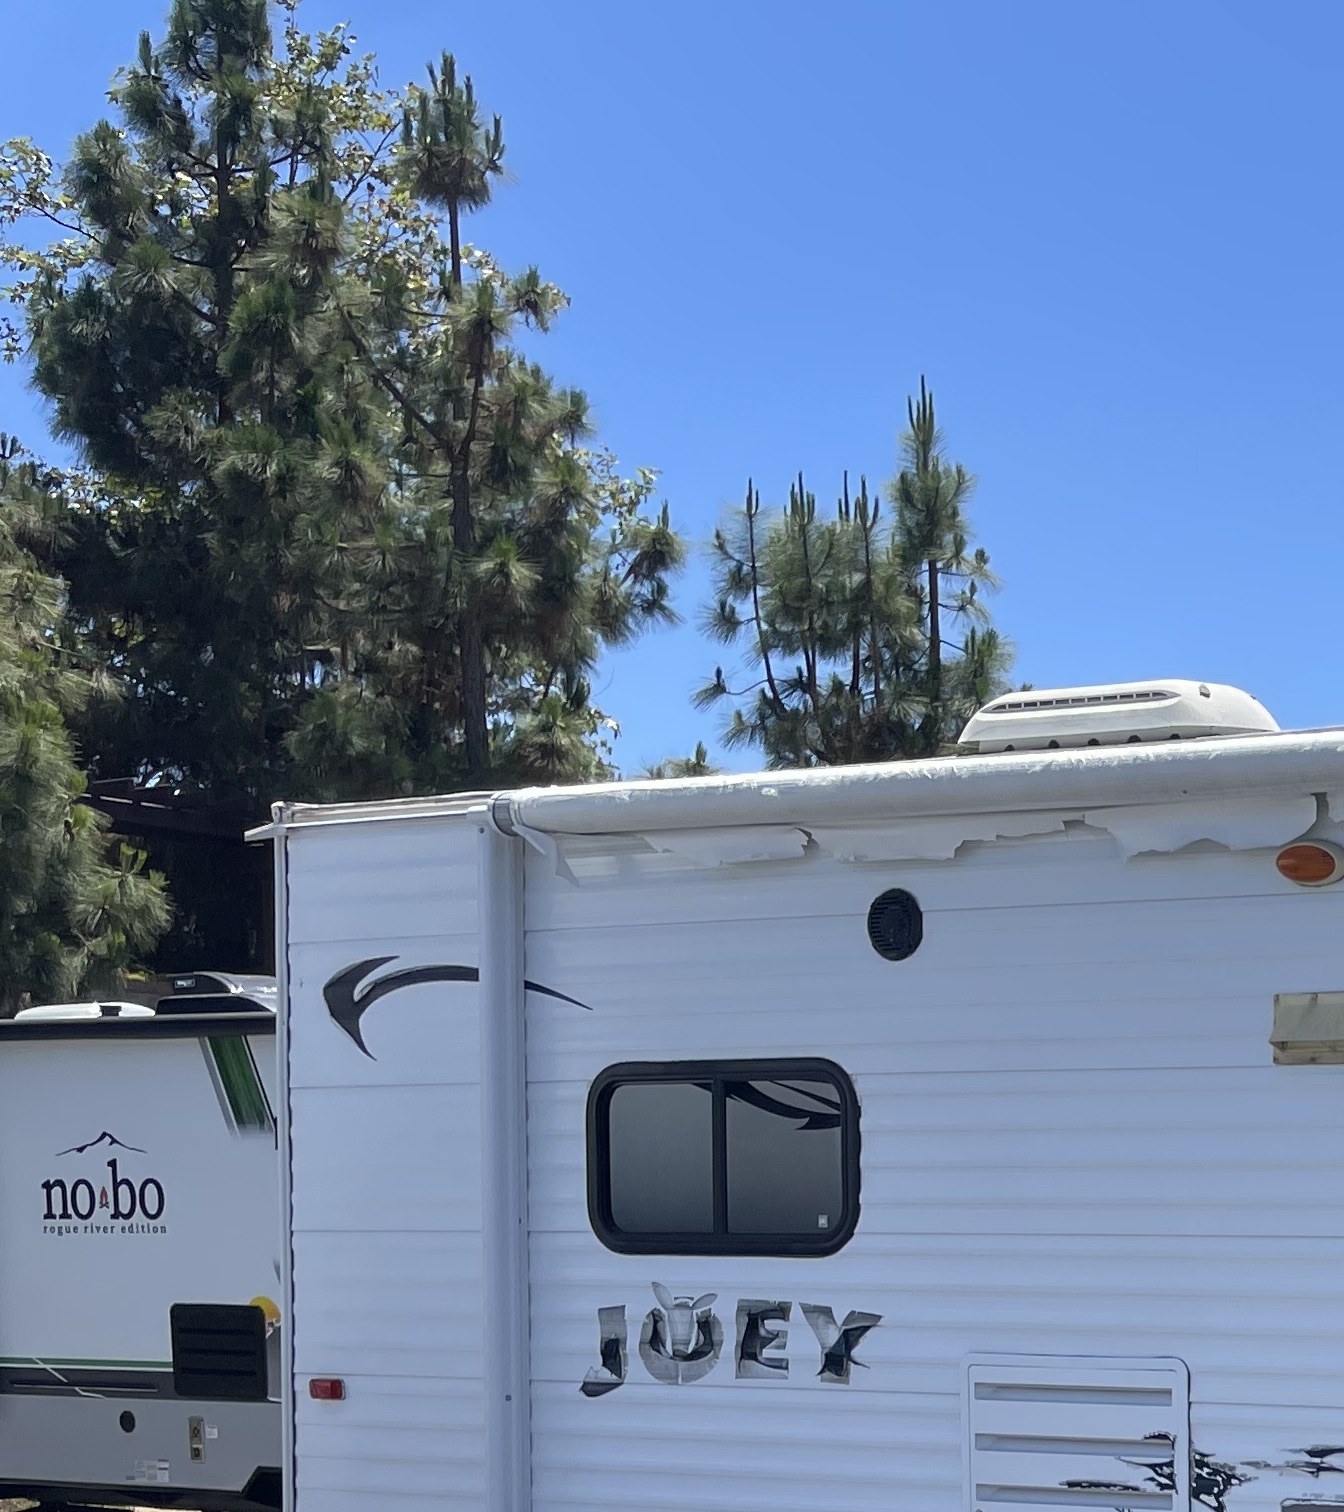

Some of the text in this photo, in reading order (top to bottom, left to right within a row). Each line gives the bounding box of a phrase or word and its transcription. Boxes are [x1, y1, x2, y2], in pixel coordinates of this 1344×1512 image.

[43, 1223, 167, 1236] rogue river edition
[579, 1297, 884, 1397] JOEY
